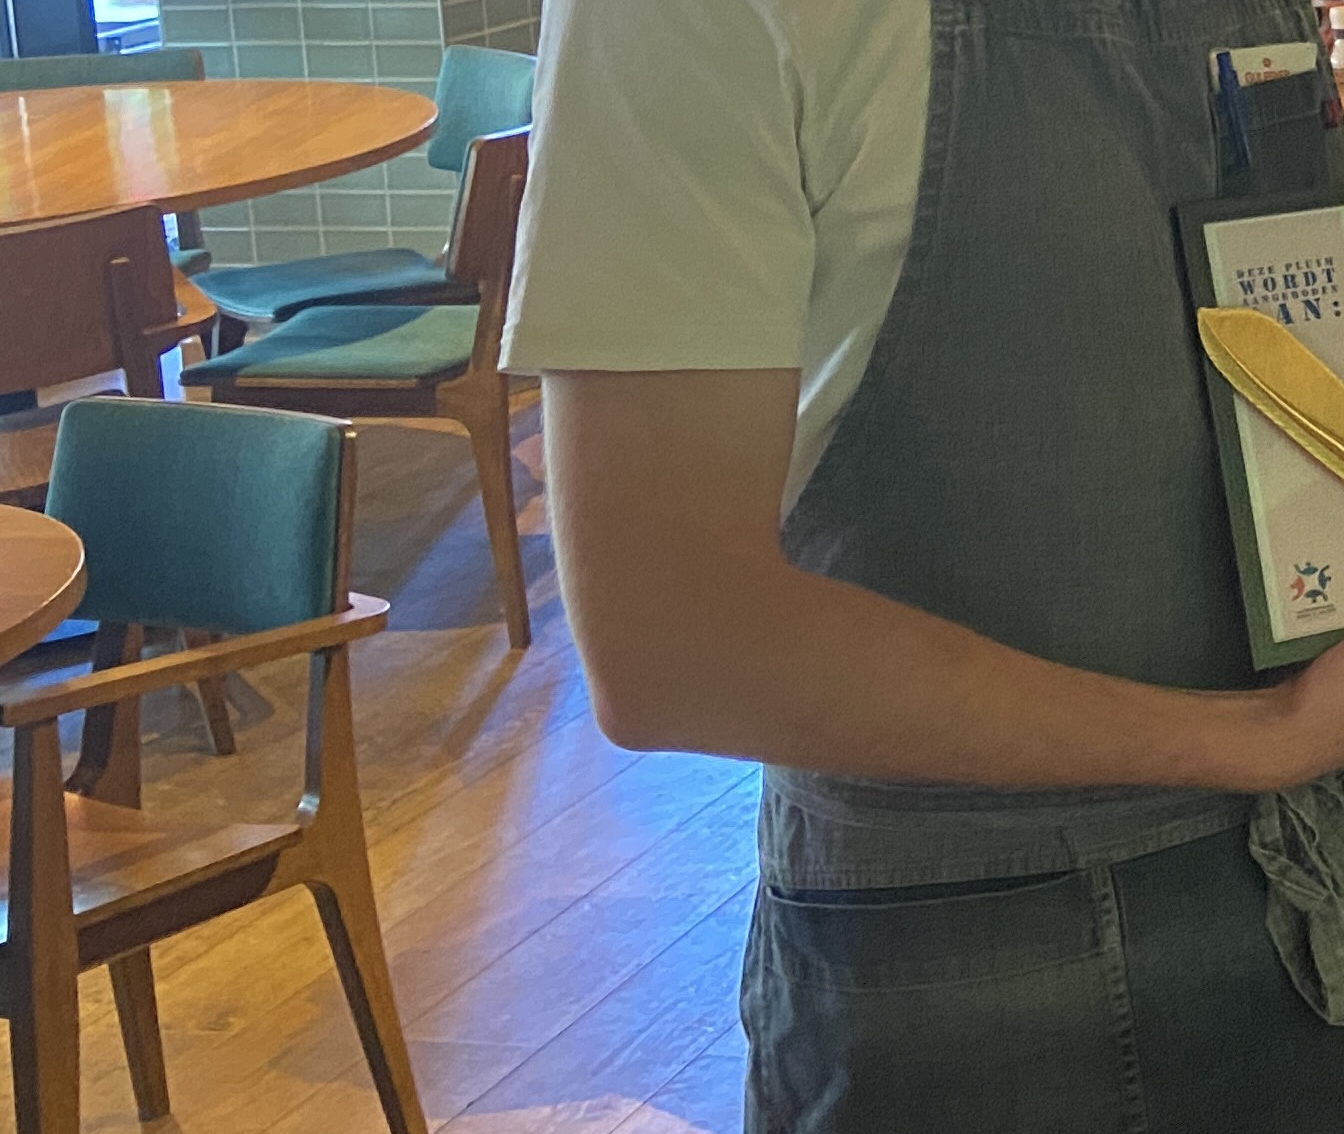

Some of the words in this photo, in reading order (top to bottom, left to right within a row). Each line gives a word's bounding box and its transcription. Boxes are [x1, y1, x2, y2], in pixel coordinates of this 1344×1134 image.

[1236, 265, 1275, 279] DEZE
[1284, 256, 1334, 272] PLUIM
[1239, 267, 1335, 296] WORDT
[1243, 284, 1338, 306] AANGEBODEN
[1276, 297, 1341, 324] AN:
